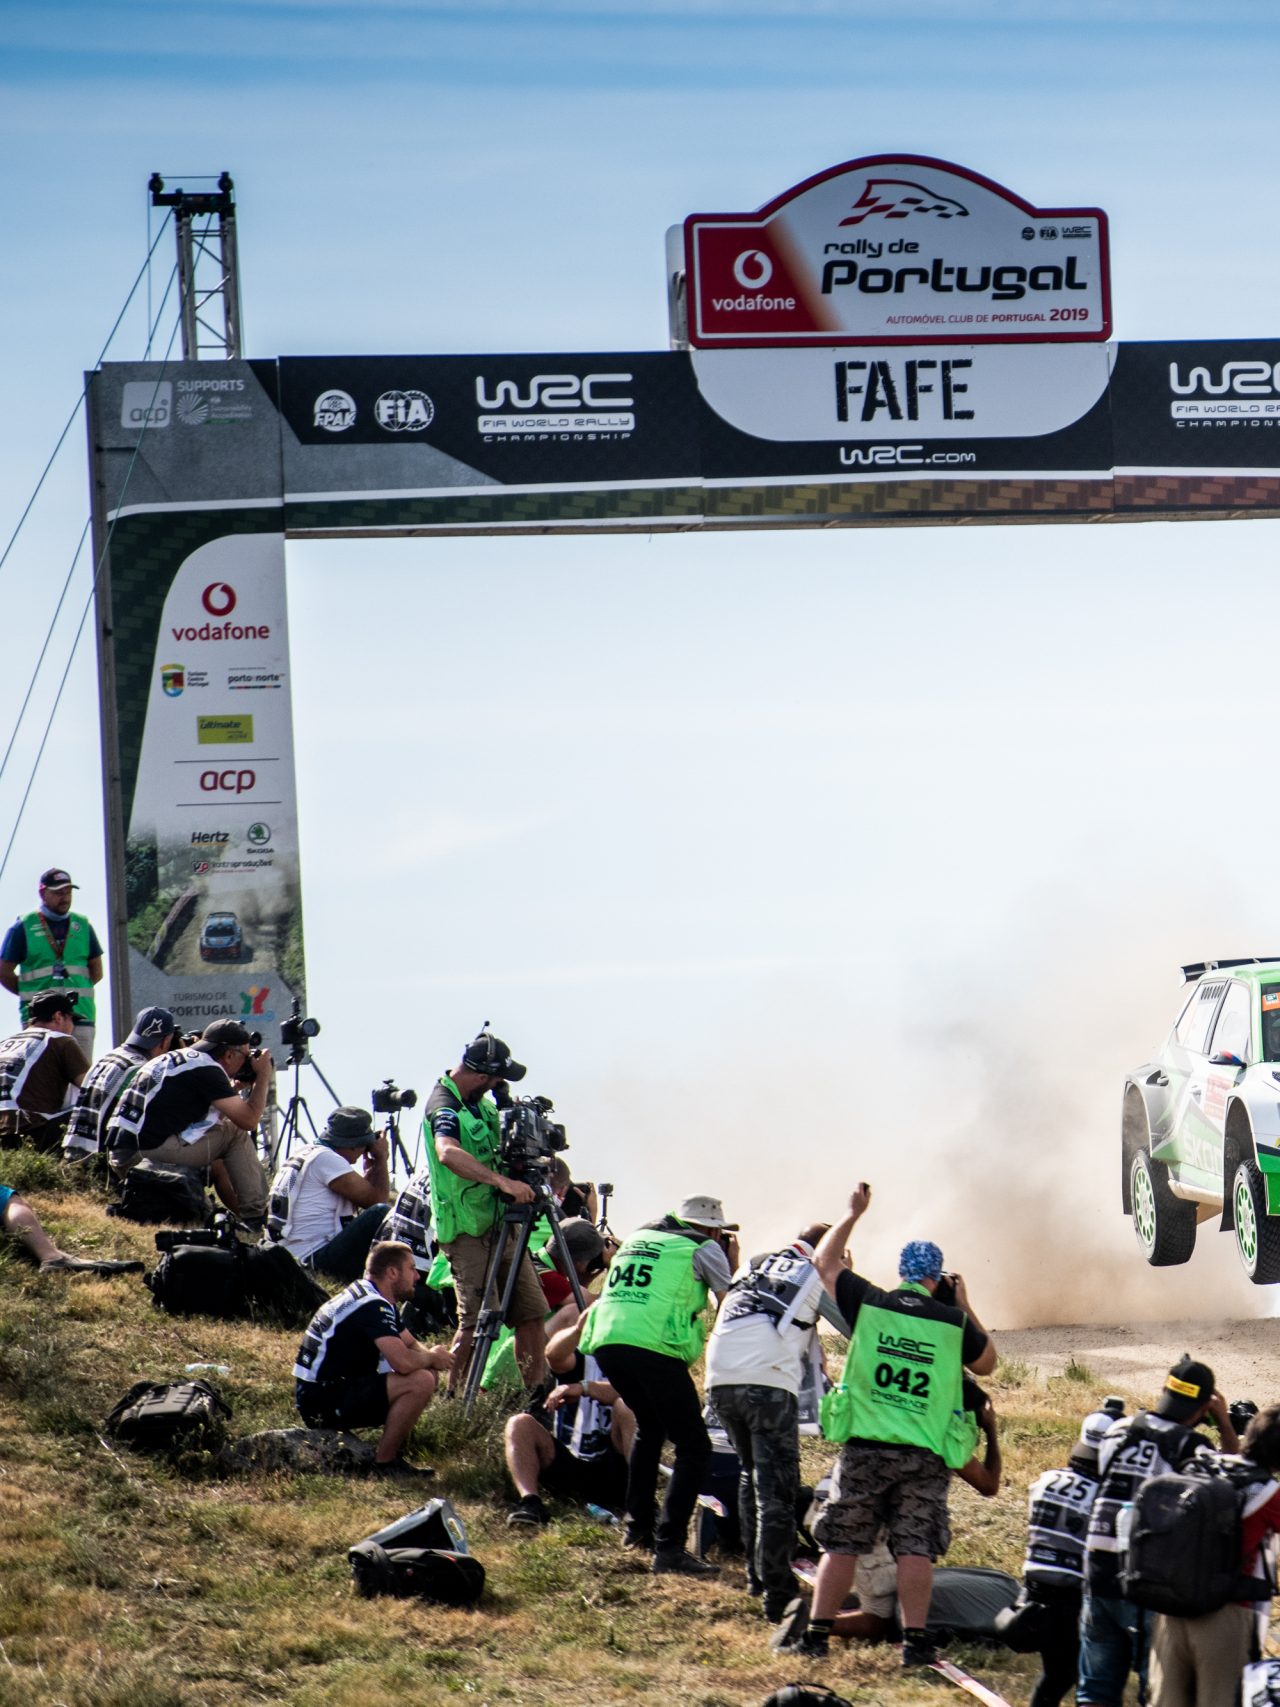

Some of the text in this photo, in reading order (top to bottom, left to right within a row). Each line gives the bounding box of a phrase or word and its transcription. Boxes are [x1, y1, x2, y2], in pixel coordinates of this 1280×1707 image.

[824, 238, 920, 258] rally de
[822, 257, 1088, 300] Portugal
[712, 294, 796, 311] vodafone
[886, 308, 1089, 324] AUTOMÓVEL CLUB DE PORTUGAL 2019
[177, 380, 245, 392] SUPPORTS
[476, 373, 634, 409] WRC
[834, 359, 975, 422] FAFE
[130, 407, 167, 424] acp
[1176, 405, 1199, 413] FIA
[1204, 404, 1260, 413] WORLD
[314, 411, 356, 426] FPAK
[483, 417, 630, 428] FIA WORLD RALLY
[483, 433, 631, 443] CHAMPIONSHIP
[171, 621, 270, 641] vodafone
[199, 769, 256, 794] acp
[191, 831, 230, 843] Hertz
[173, 991, 228, 1001] TURISMO DE
[168, 1004, 237, 1017] PORTUGAL
[608, 1263, 653, 1288] 045
[878, 1331, 937, 1356] WRC
[874, 1362, 931, 1399] 042
[1045, 1473, 1092, 1501] 225
